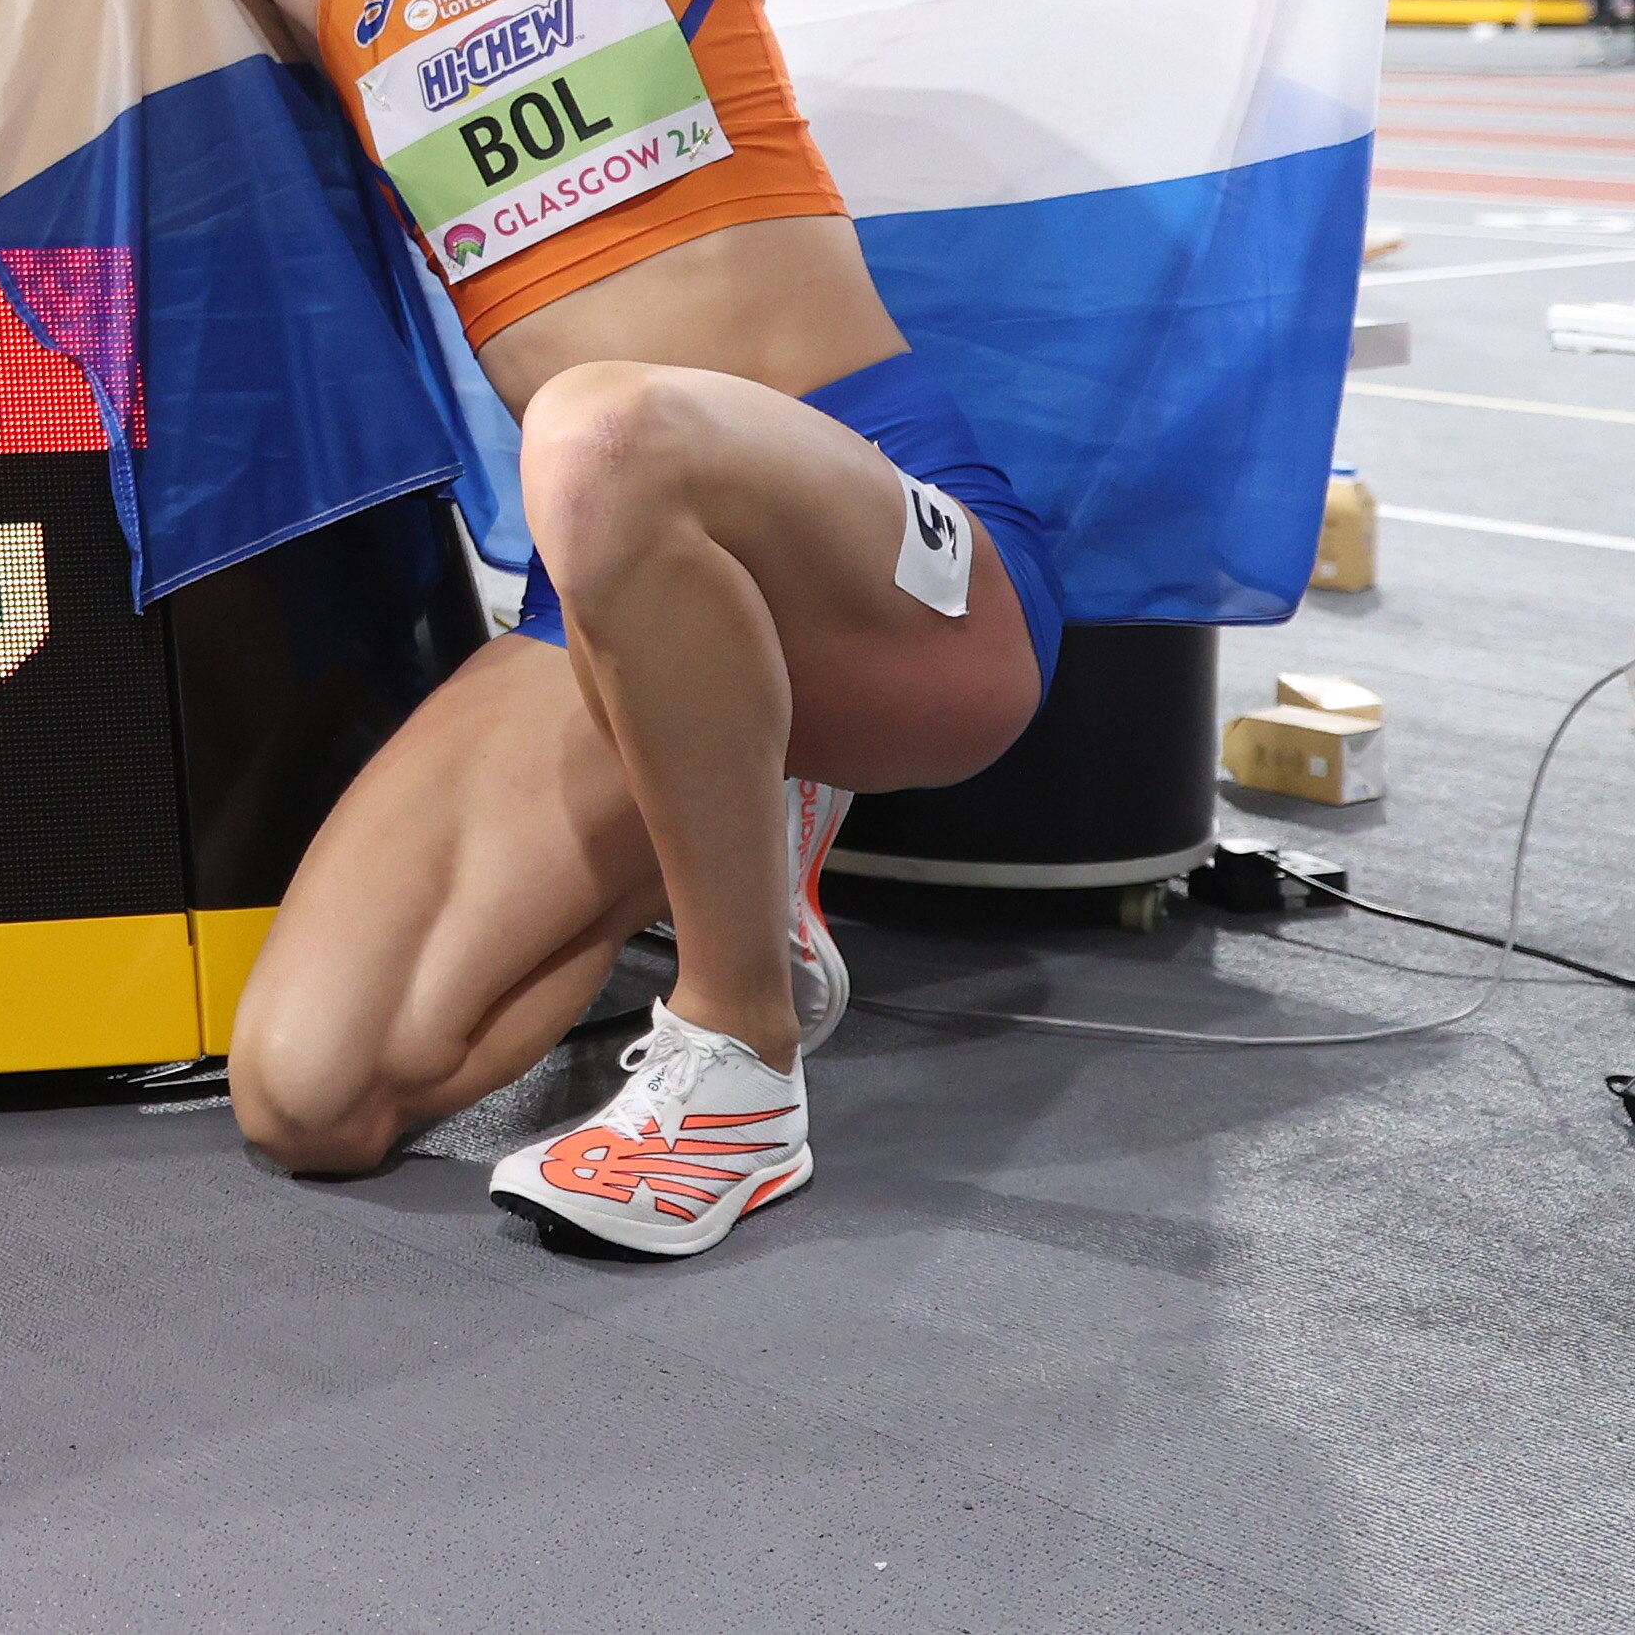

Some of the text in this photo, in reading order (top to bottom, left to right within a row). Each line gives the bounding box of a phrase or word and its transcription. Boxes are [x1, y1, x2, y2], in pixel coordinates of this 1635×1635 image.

[459, 77, 614, 187] BOL
[494, 121, 711, 236] GLASGOW 24
